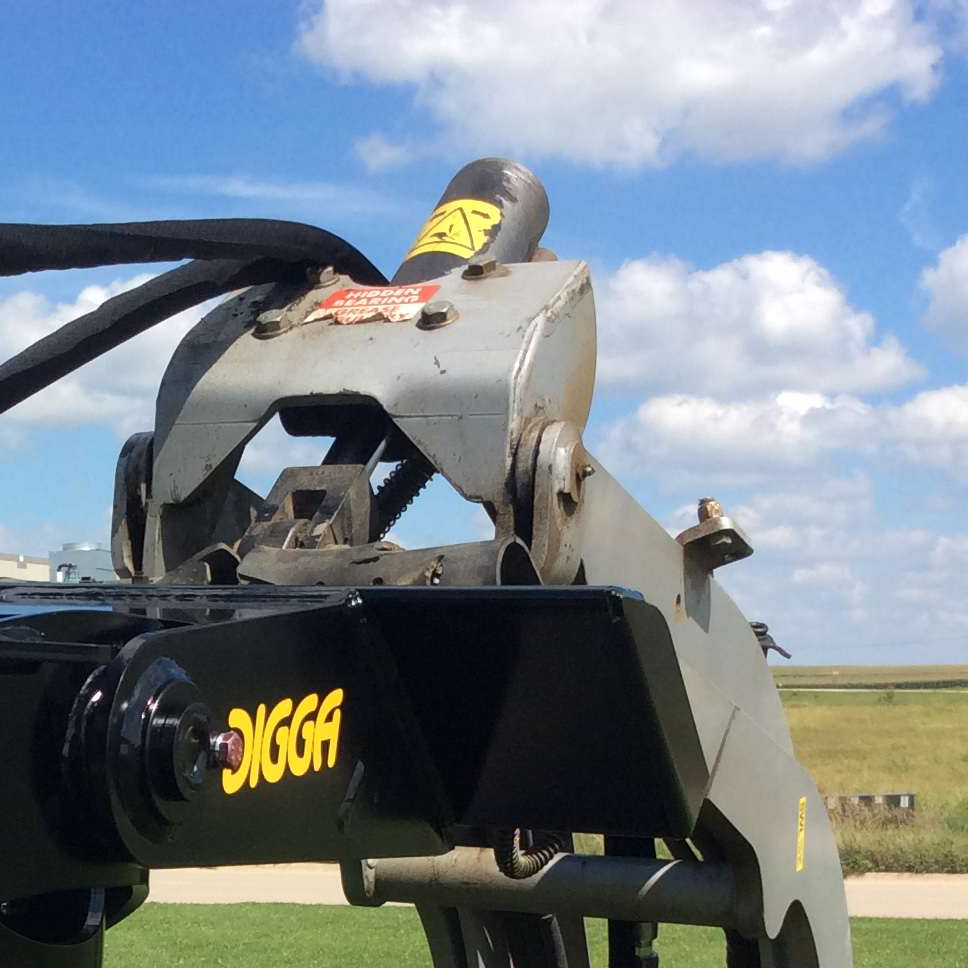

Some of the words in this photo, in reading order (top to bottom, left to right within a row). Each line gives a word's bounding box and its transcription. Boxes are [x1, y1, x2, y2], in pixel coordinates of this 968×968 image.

[345, 287, 423, 299] HIDDEN
[332, 295, 420, 307] BEARING
[222, 688, 344, 795] DIGGA
